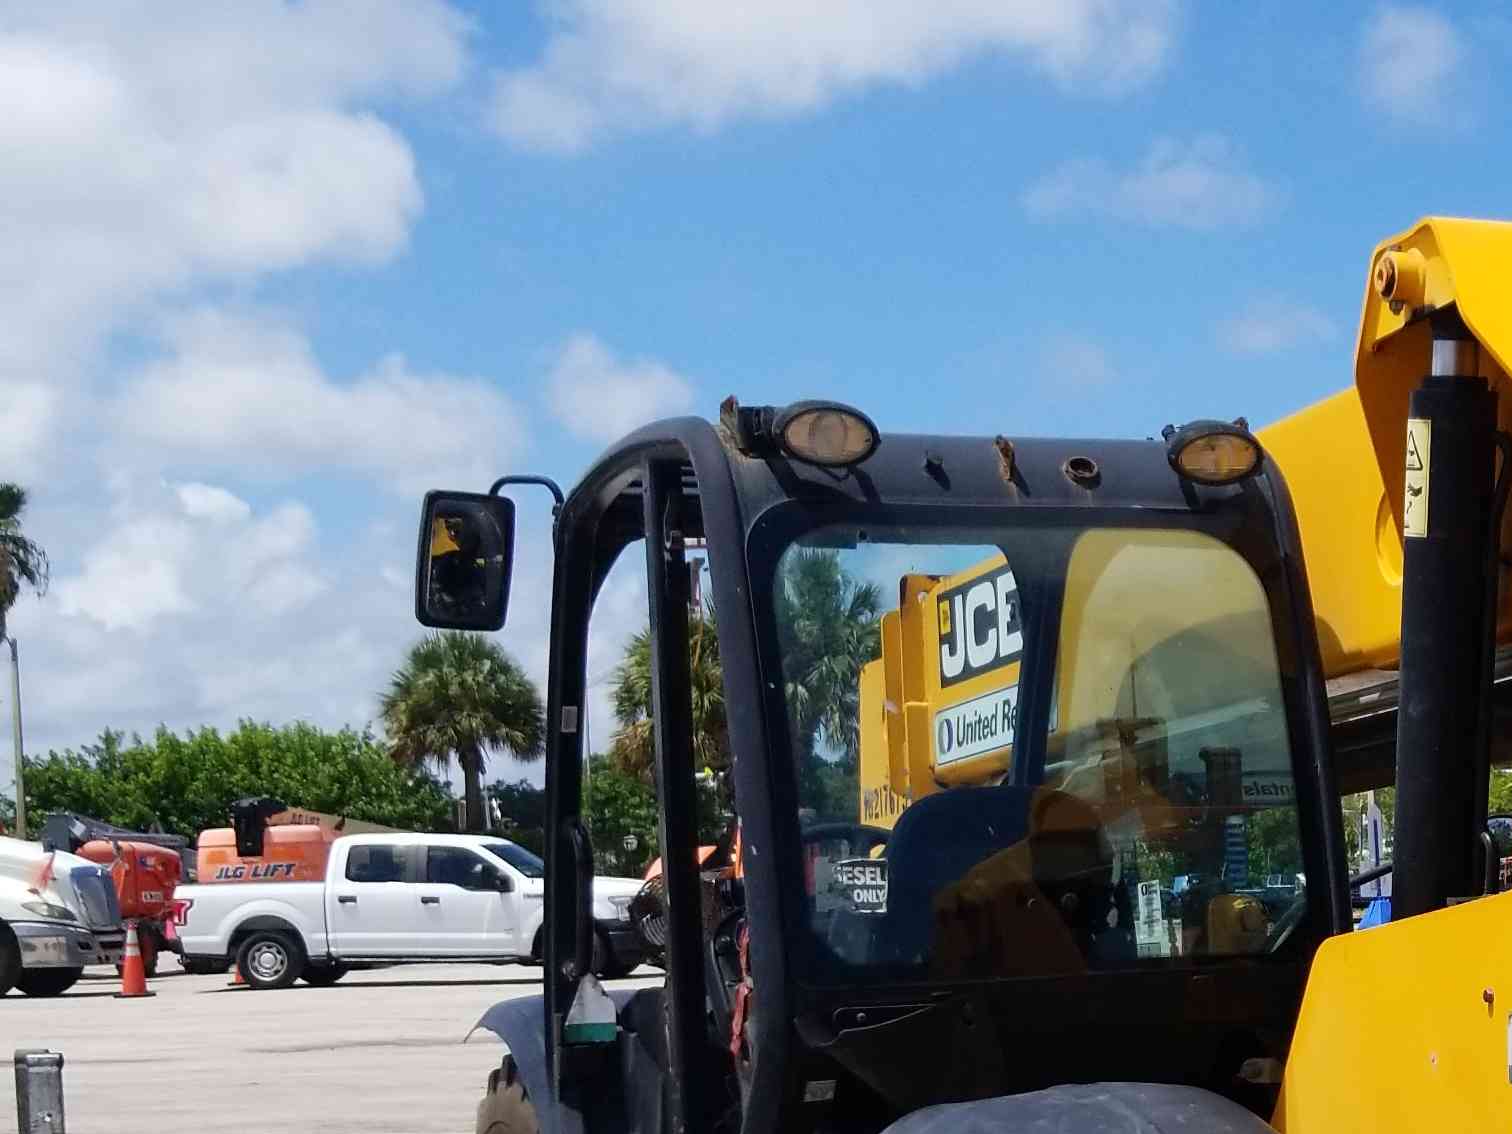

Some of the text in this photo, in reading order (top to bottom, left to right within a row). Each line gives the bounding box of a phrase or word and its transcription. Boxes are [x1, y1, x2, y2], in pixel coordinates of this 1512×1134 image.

[956, 703, 998, 748] United
[215, 863, 297, 879] JLG LIFT
[853, 887, 886, 903] ONLY
